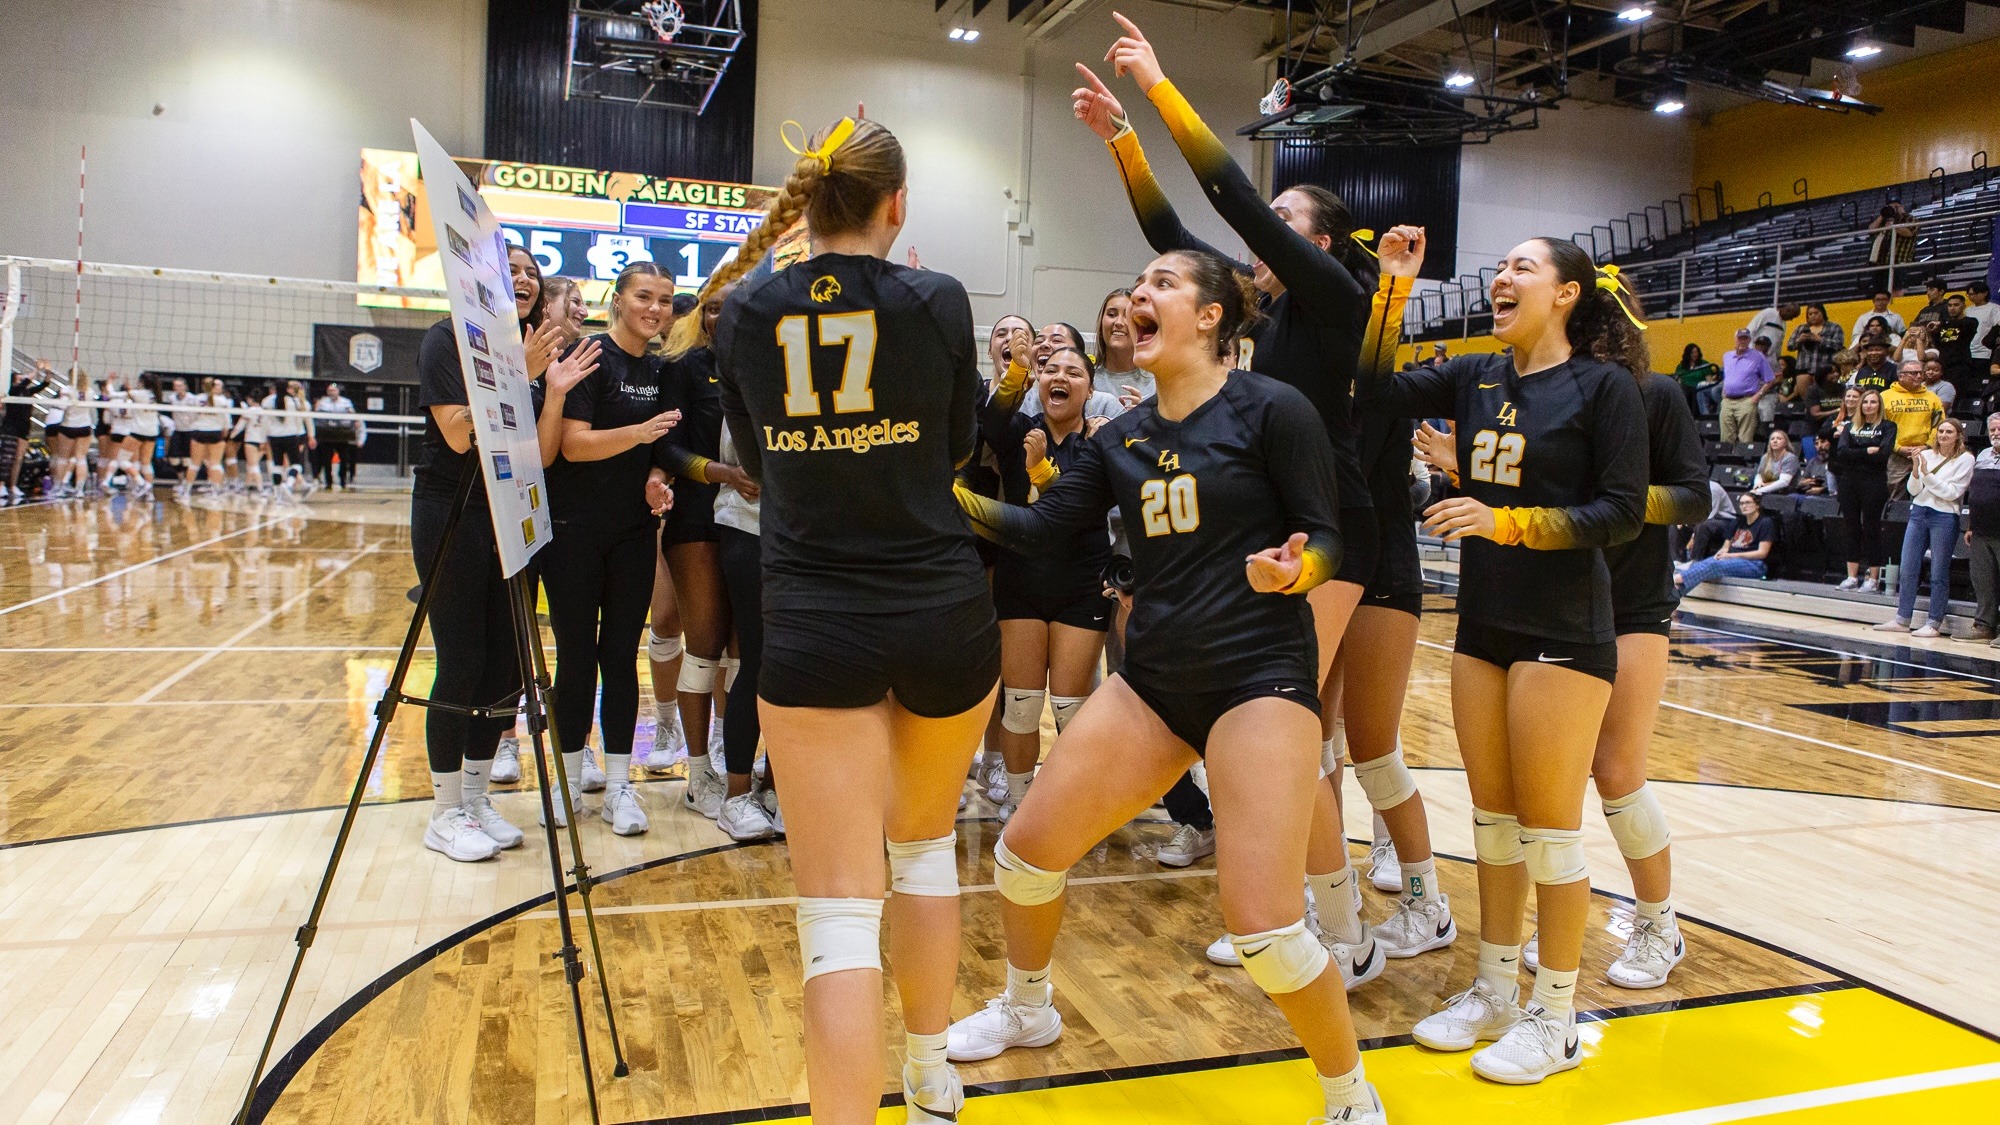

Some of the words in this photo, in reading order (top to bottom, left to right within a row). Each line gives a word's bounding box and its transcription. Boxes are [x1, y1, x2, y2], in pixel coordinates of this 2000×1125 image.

[378, 161, 400, 193] LA
[493, 165, 606, 195] GOLDEN
[654, 180, 746, 208] EAGLES
[377, 199, 400, 248] ARE
[685, 212, 710, 229] SF
[714, 215, 763, 233] STAT
[610, 239, 631, 247] SET
[611, 251, 629, 275] 3
[775, 309, 878, 417] 17
[1496, 401, 1518, 427] LA
[1890, 399, 1906, 407] CAL
[1908, 398, 1930, 407] STATE
[763, 426, 807, 452] Los
[810, 418, 920, 454] Angeles
[1157, 450, 1181, 473] LA
[1470, 429, 1527, 488] 22
[1140, 473, 1200, 537] 20
